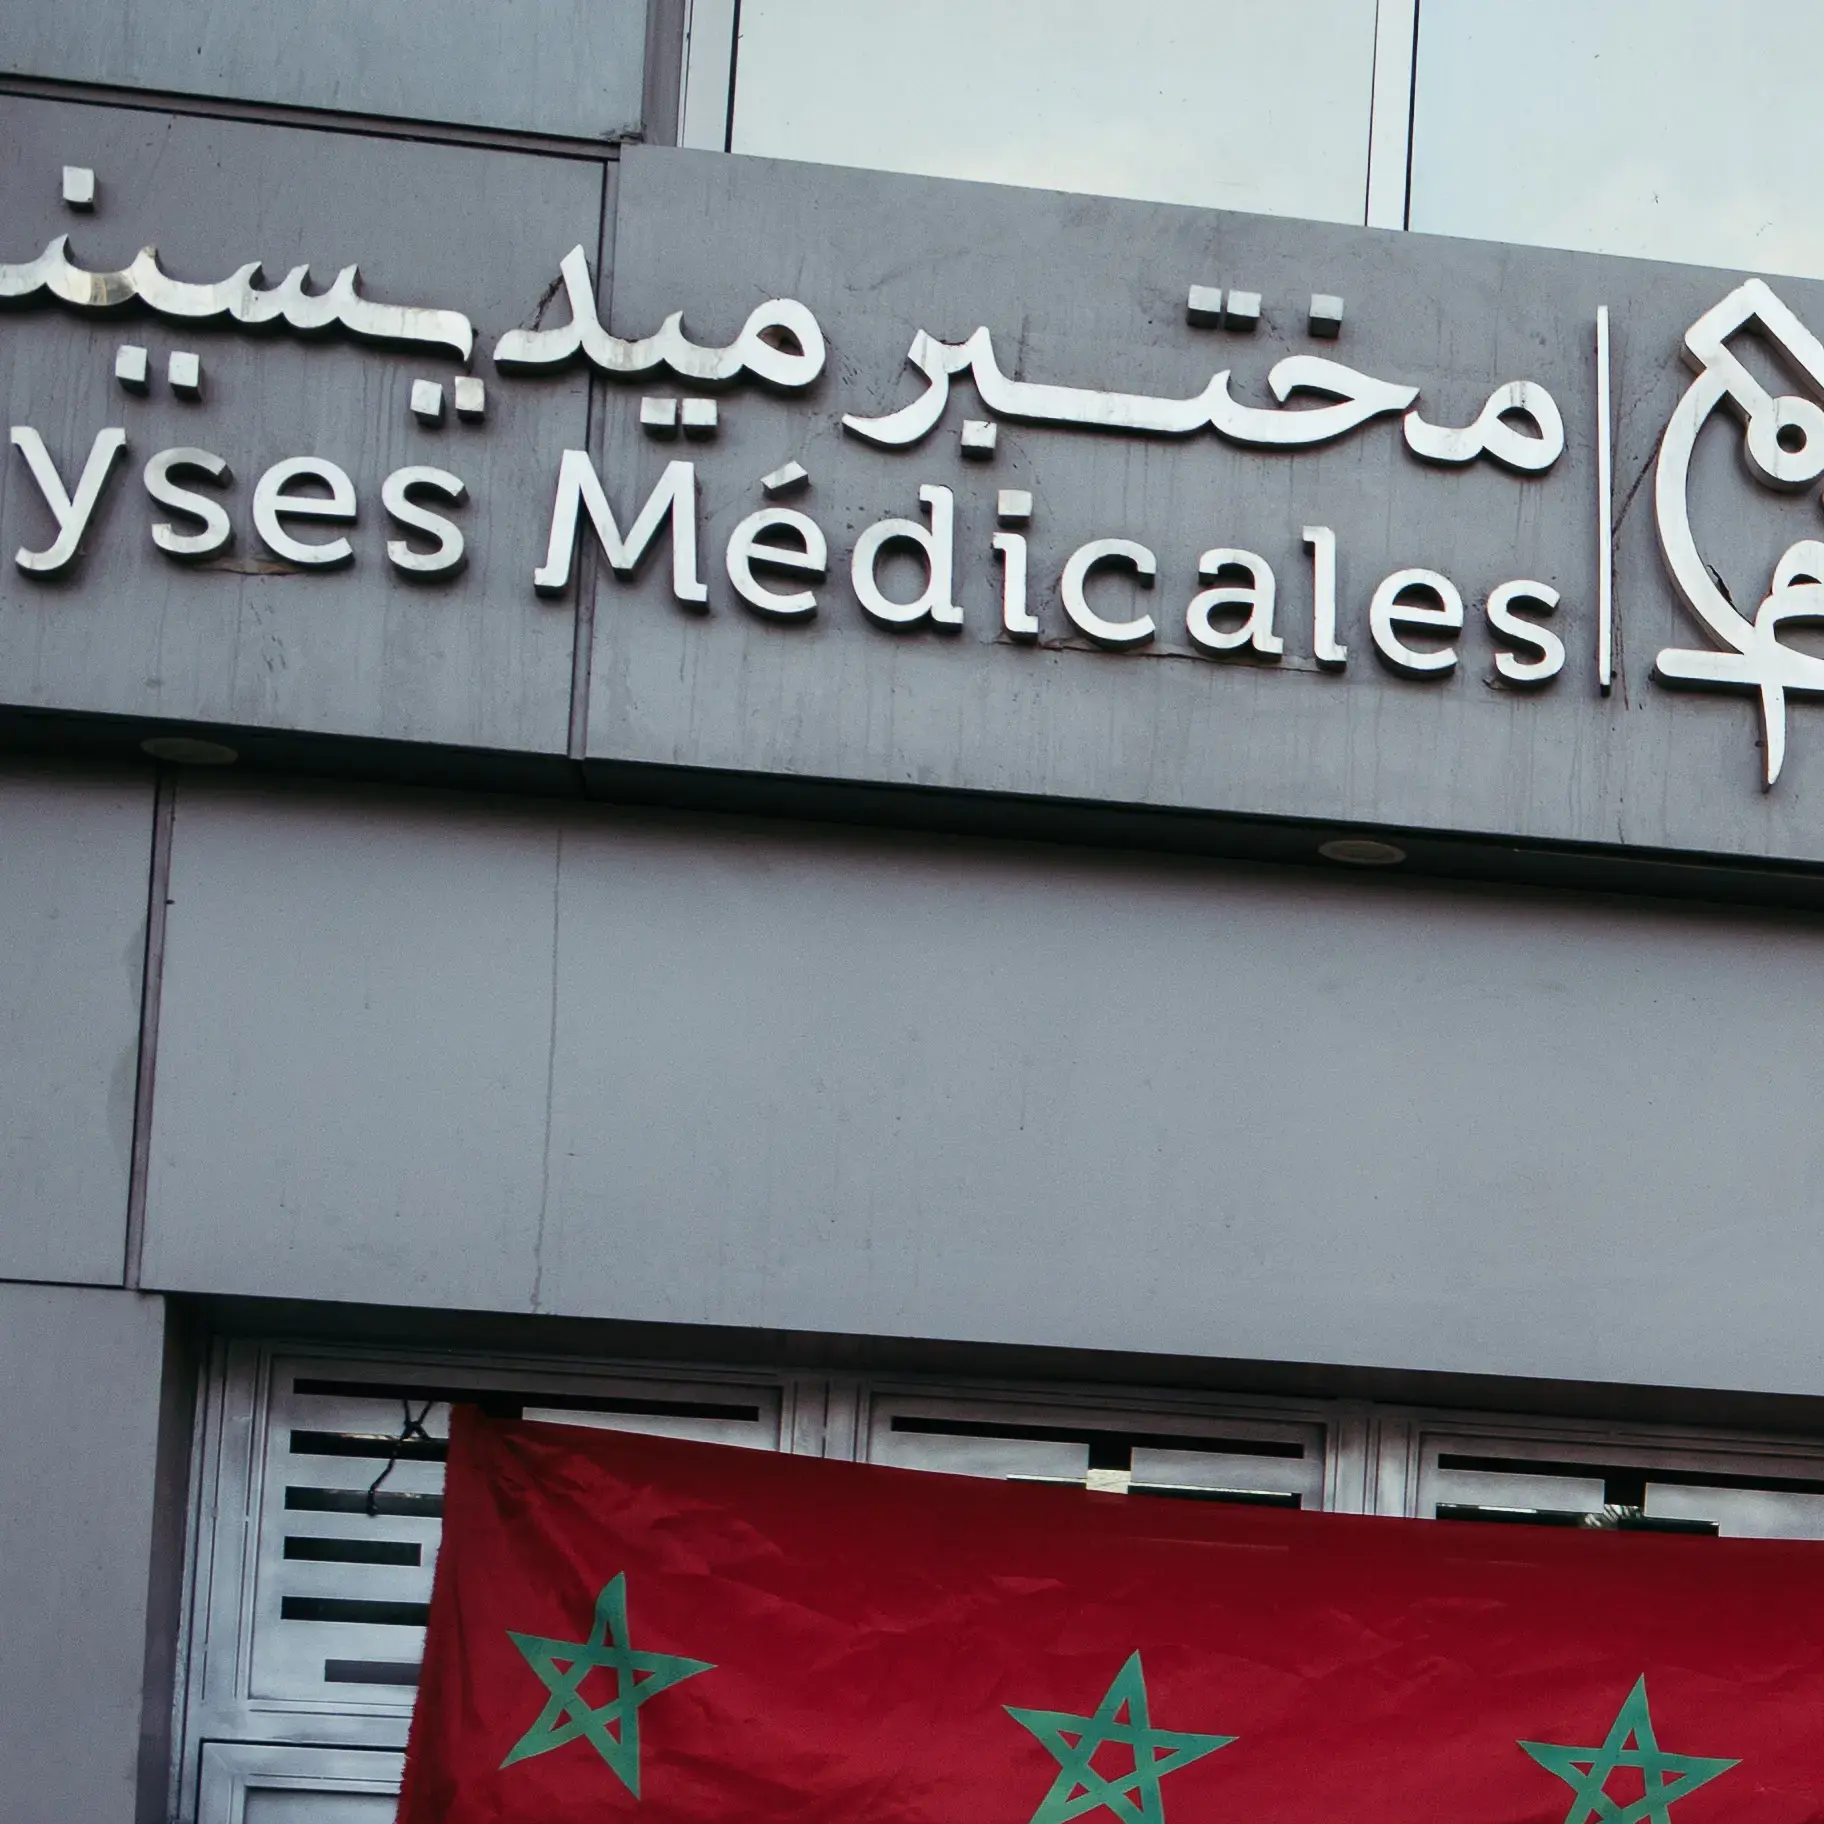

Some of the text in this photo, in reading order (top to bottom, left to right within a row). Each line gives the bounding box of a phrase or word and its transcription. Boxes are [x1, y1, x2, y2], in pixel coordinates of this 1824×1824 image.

[0, 165, 1566, 472] مختبر ميديسين
[534, 447, 1567, 688] Médicales
